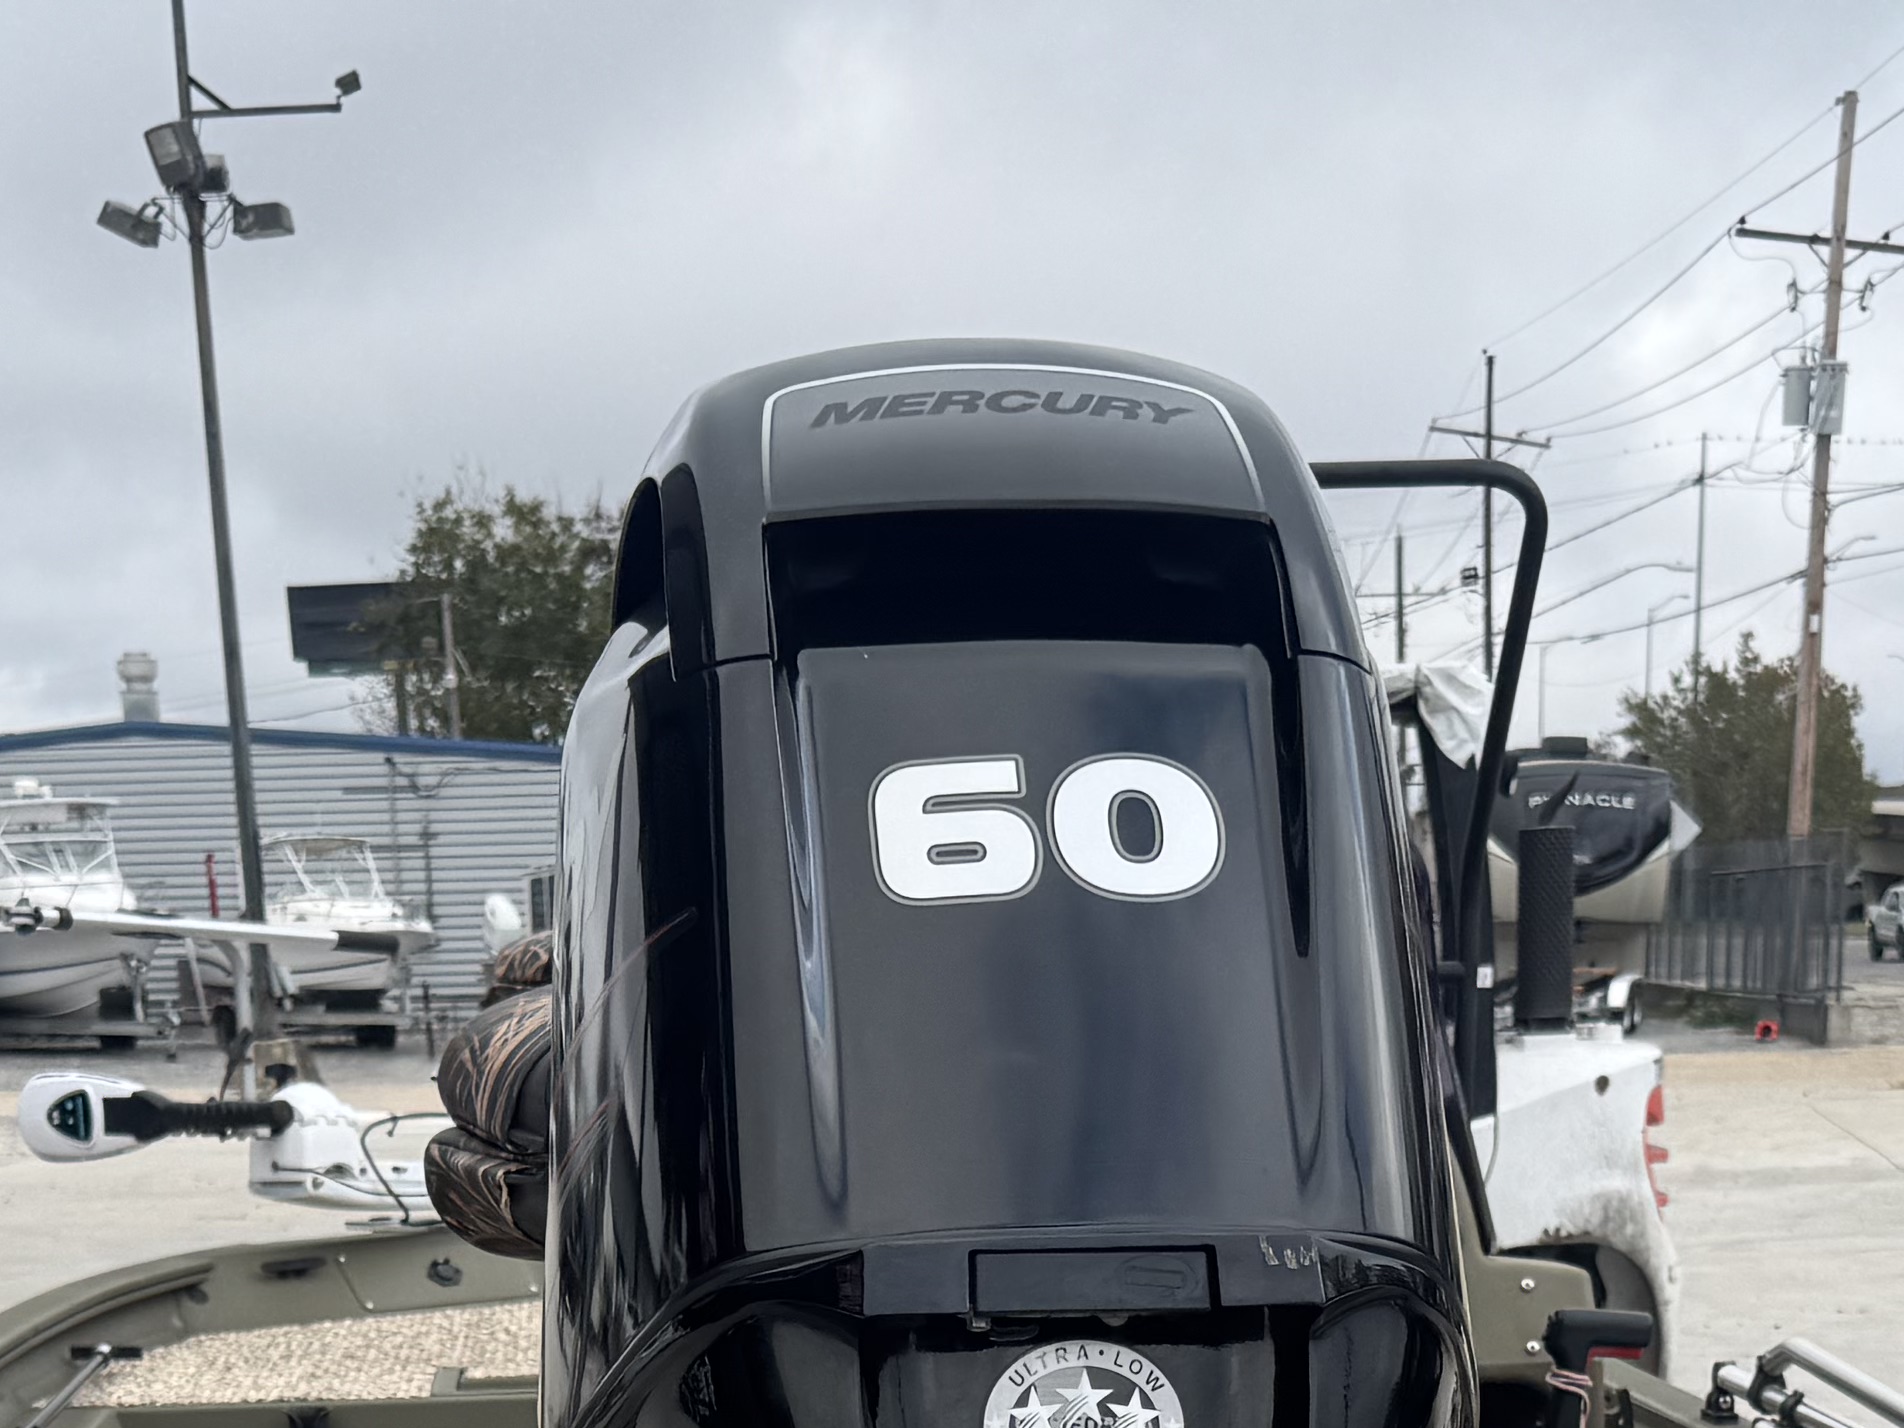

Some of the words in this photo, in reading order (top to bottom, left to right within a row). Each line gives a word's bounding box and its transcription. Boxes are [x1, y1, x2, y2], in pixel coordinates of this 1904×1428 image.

[810, 390, 1193, 429] MERCURY
[1528, 791, 1635, 809] PNACLE
[868, 752, 1226, 905] 60
[1009, 1344, 1089, 1388] ULTRA
[1114, 1350, 1165, 1392] LOW
